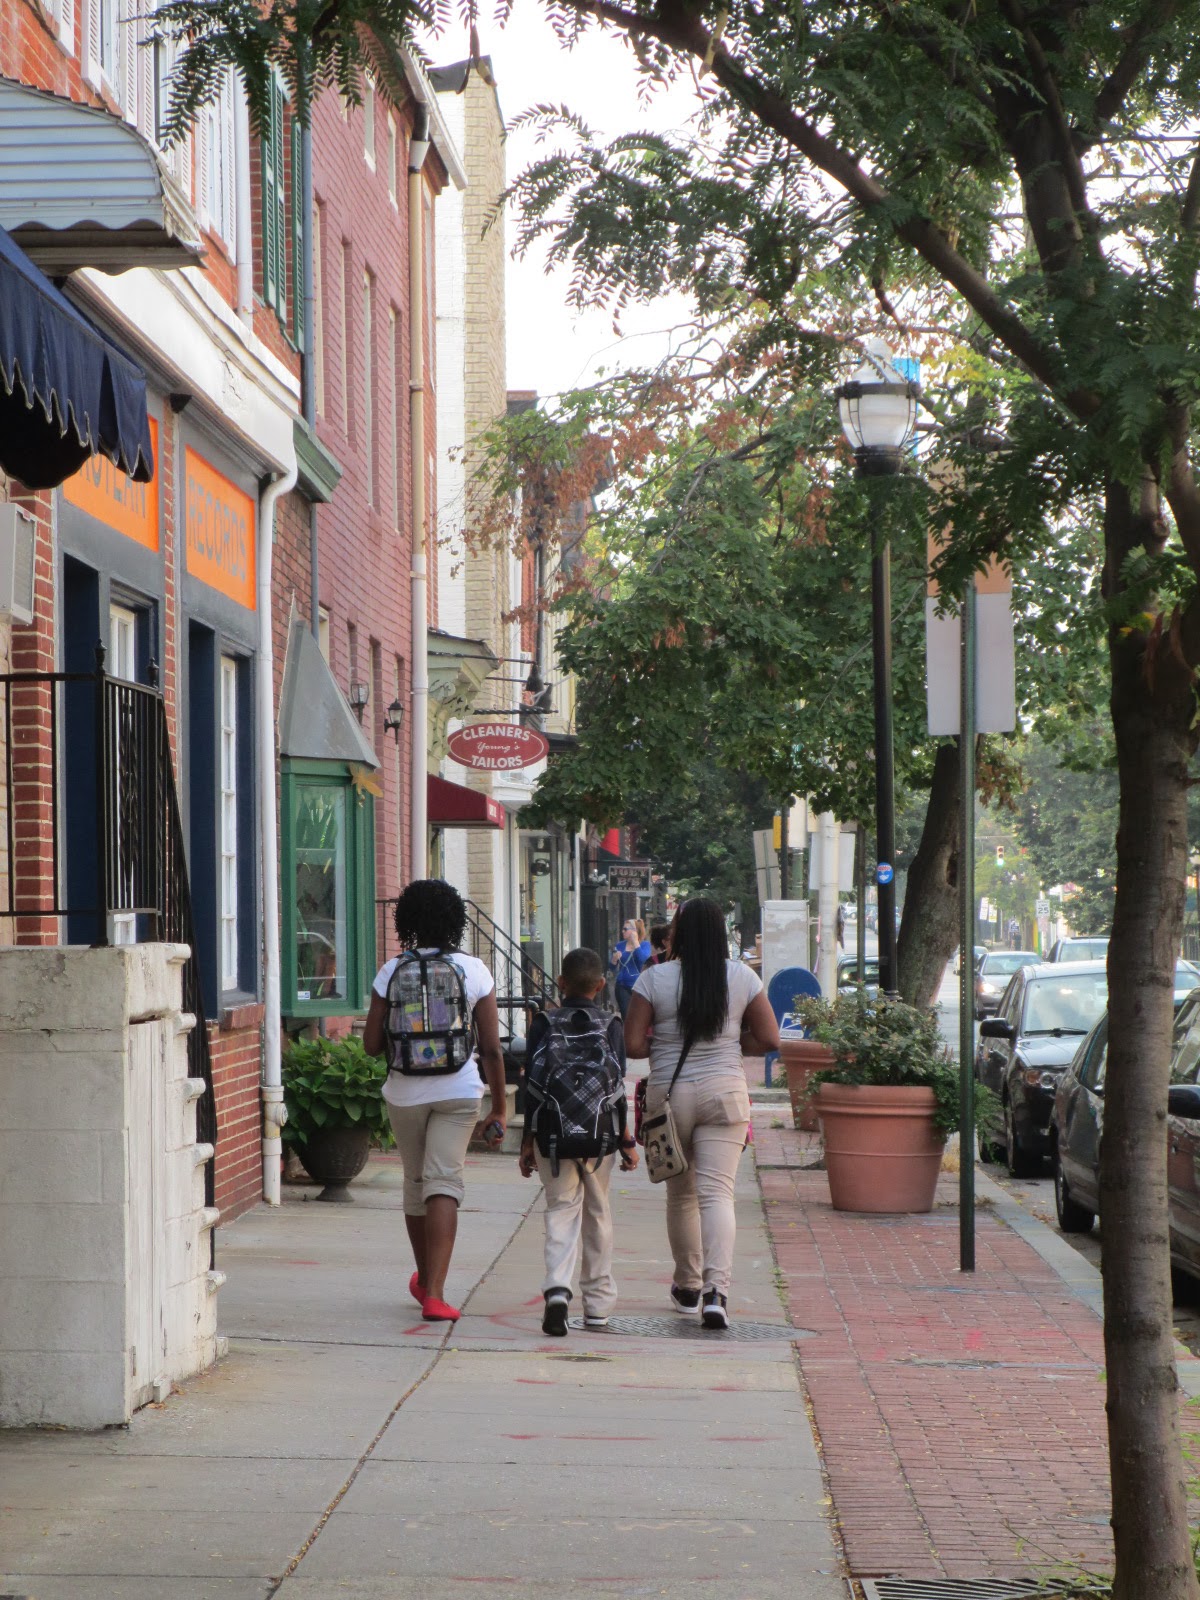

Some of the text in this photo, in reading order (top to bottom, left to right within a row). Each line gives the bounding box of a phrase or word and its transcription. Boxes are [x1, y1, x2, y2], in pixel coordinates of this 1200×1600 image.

[189, 475, 246, 585] RECORDS
[462, 725, 531, 741] CLEANERS
[477, 741, 520, 753] Young's
[471, 755, 523, 769] TAILORS
